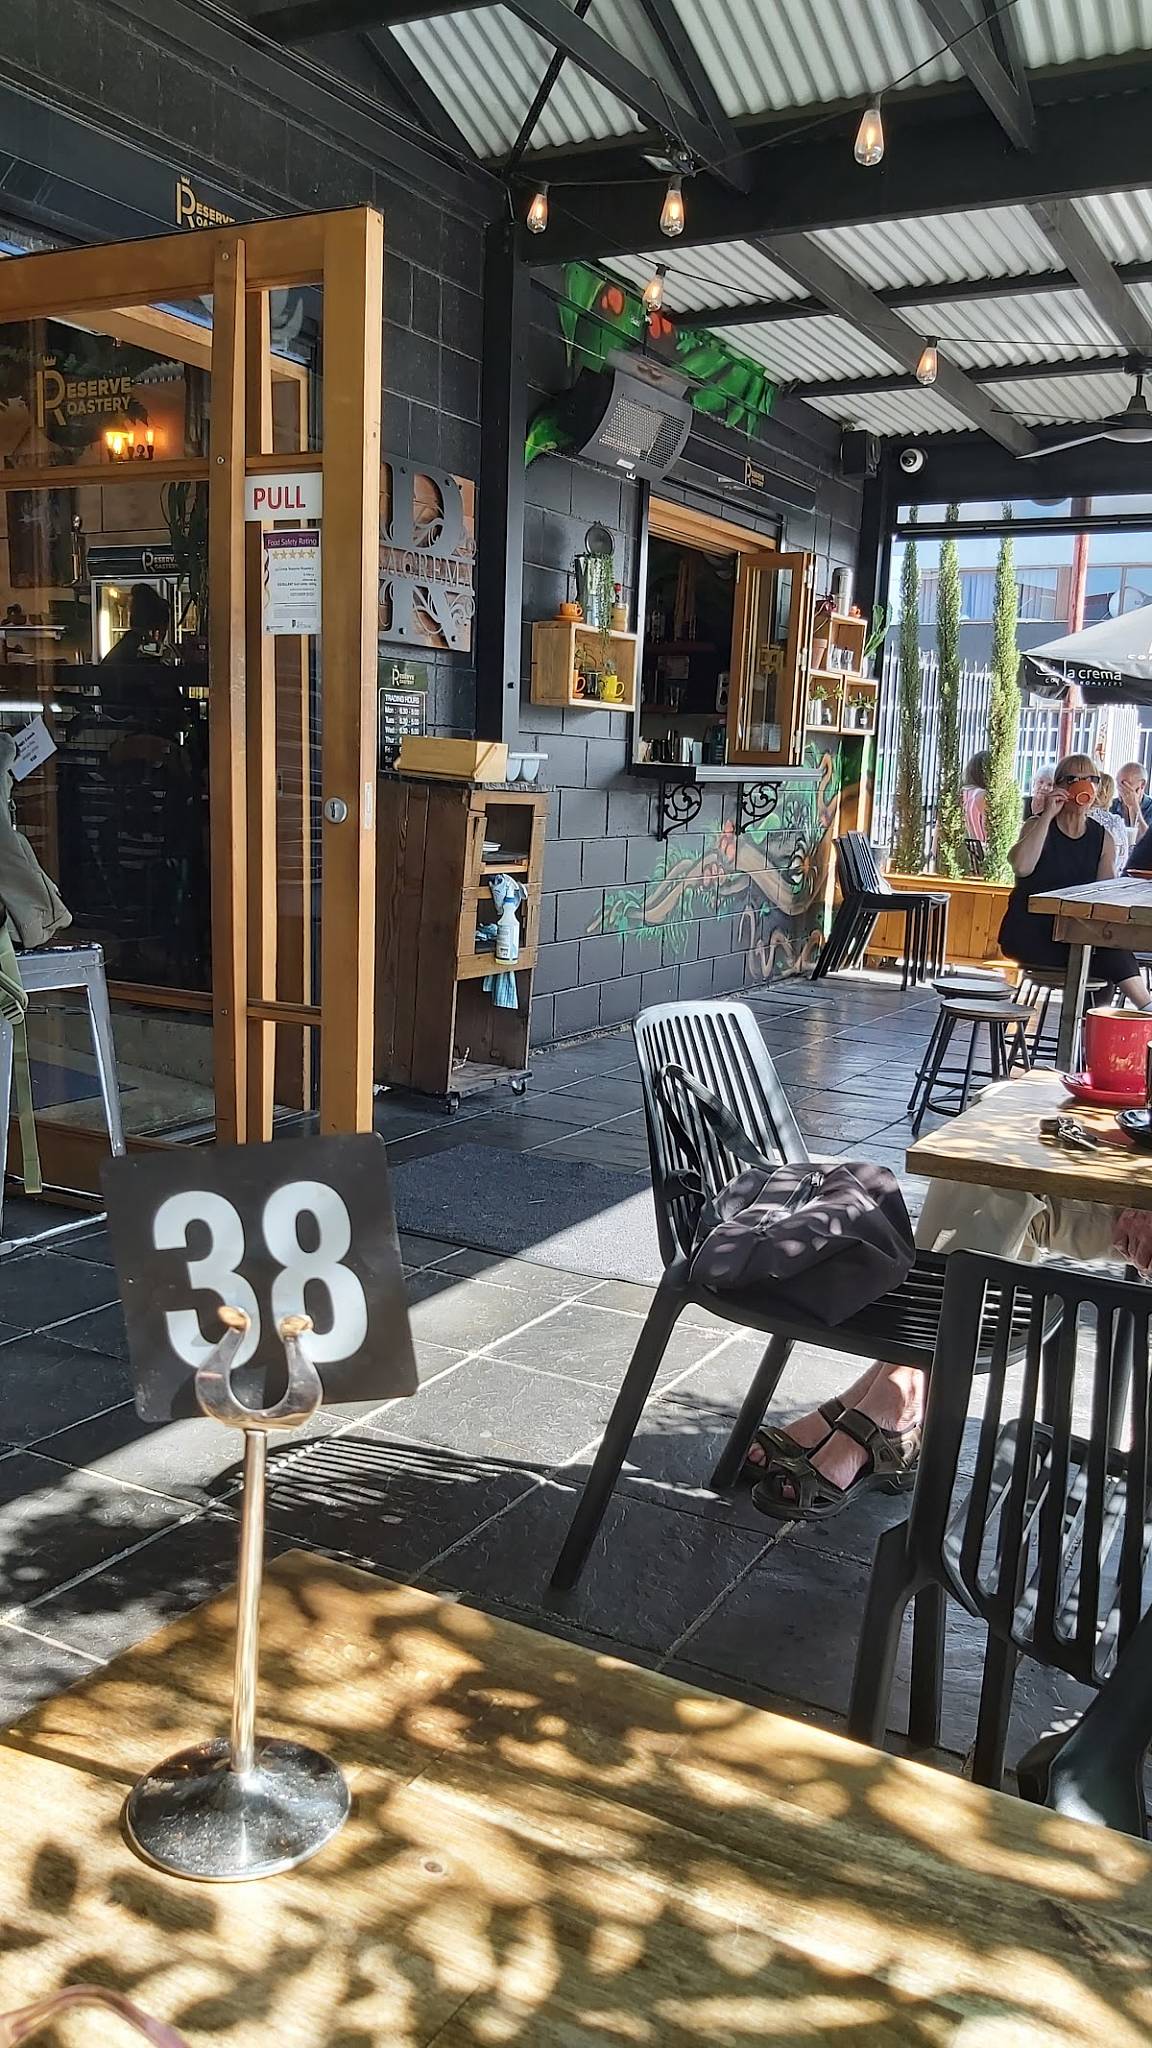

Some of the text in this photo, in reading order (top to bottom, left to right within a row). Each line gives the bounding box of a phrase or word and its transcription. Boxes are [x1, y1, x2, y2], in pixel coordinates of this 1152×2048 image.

[253, 485, 306, 511] PULL
[267, 536, 317, 547] Food Safety Rating
[1063, 659, 1122, 681] la crema
[385, 694, 420, 704] TRADING HOURS
[153, 1180, 368, 1369] 38
